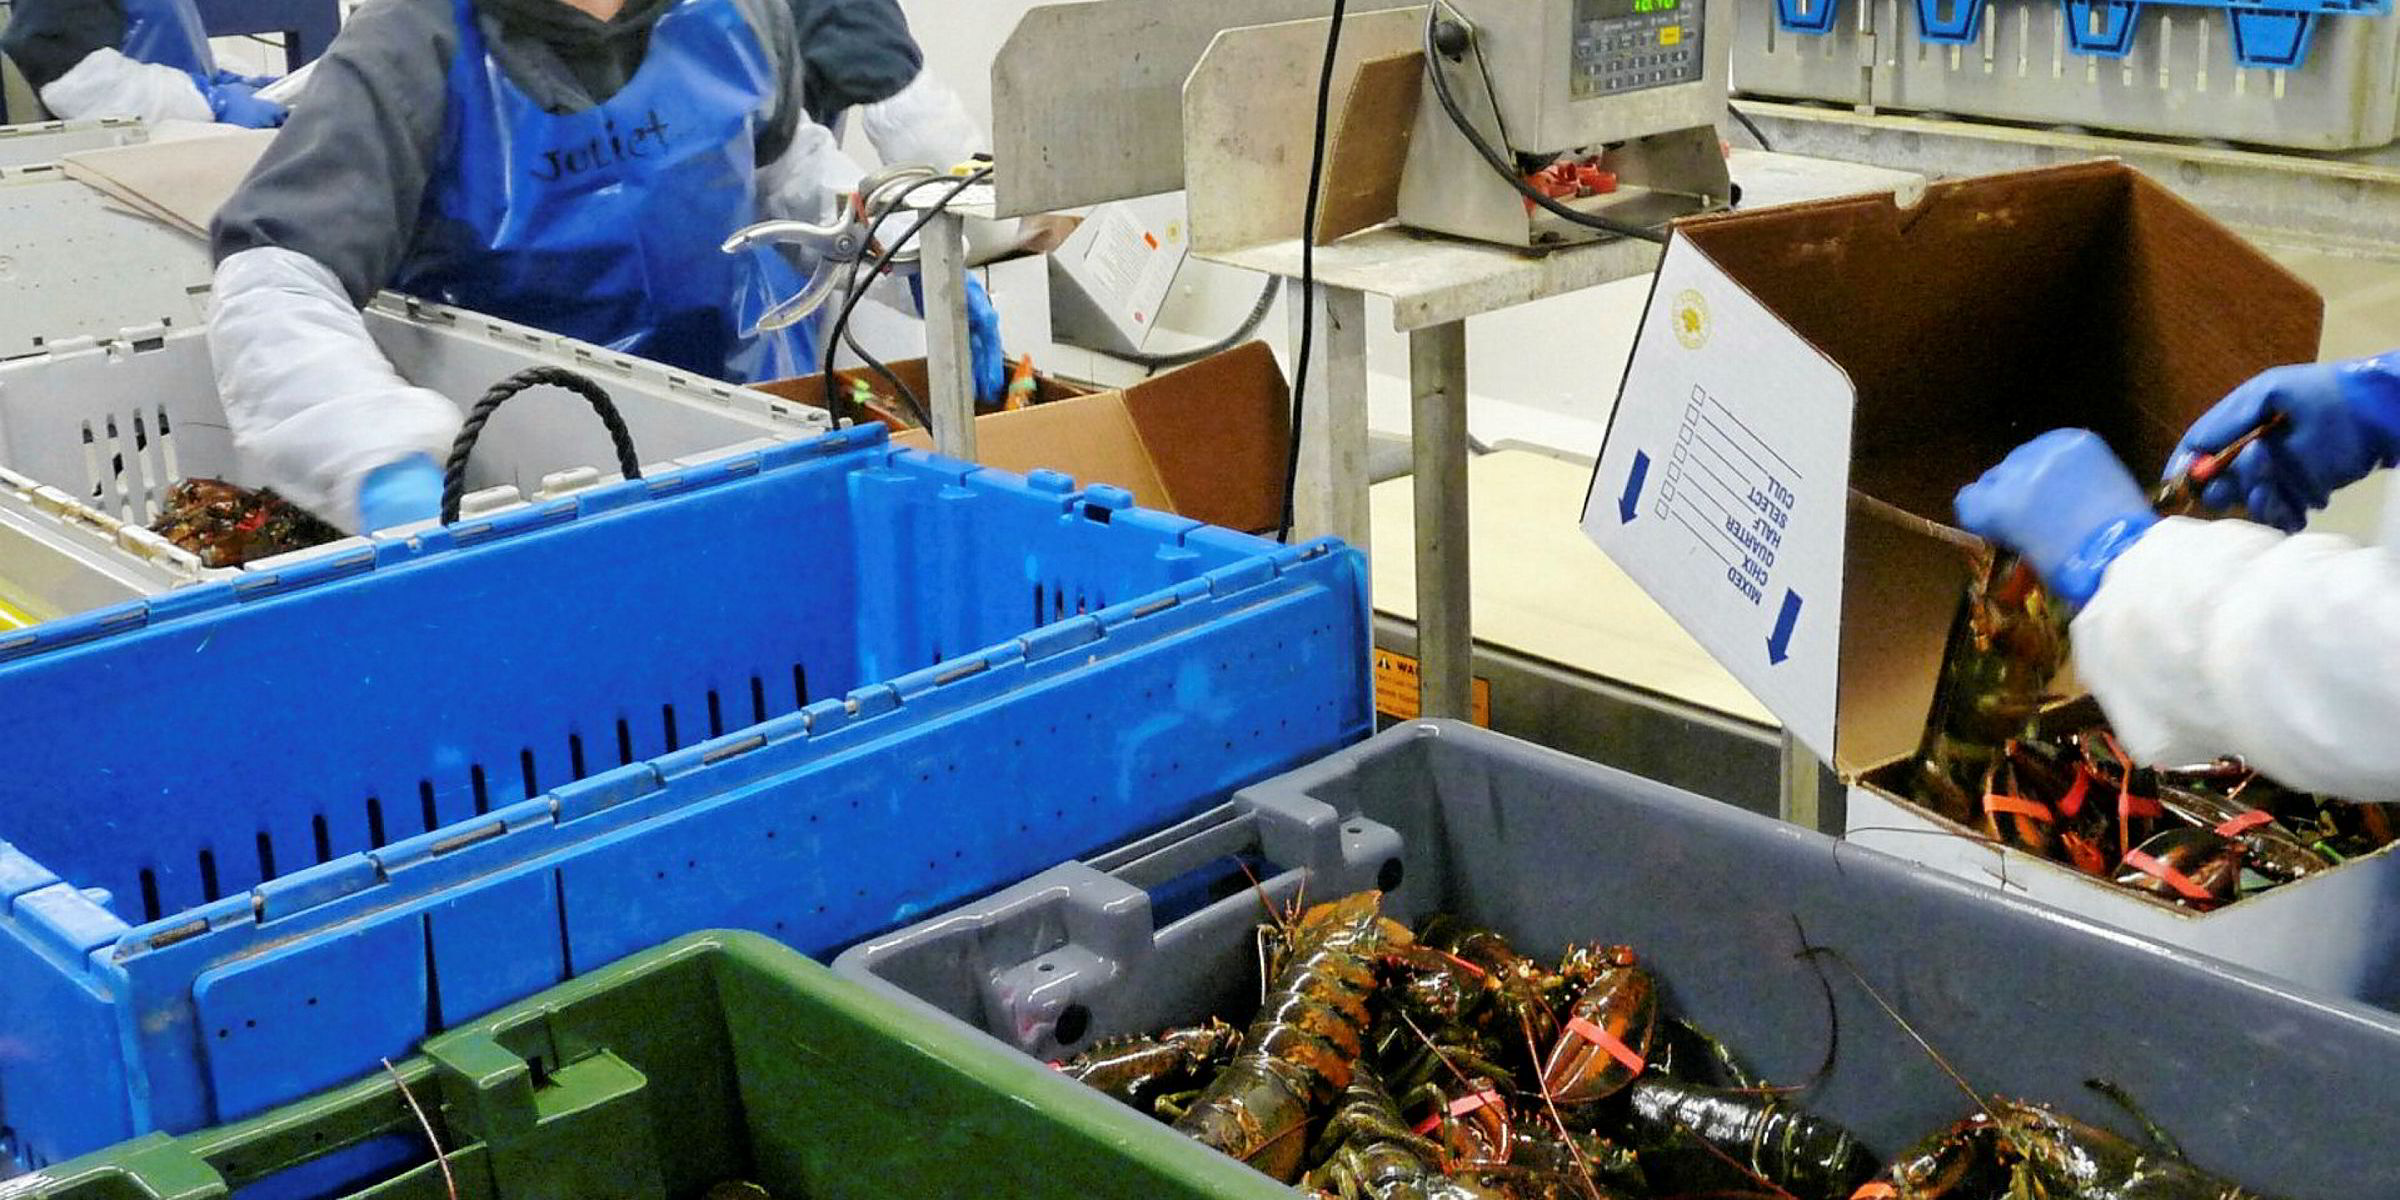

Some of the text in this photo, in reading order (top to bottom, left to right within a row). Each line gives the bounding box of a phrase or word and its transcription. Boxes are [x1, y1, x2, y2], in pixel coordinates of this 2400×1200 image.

[1747, 487, 1788, 529] SELECT
[1767, 475, 1795, 510] CULL
[1726, 515, 1775, 567] QUARTER
[1753, 518, 1782, 548] HALF
[1727, 568, 1762, 606] MIXED
[1742, 555, 1769, 587] CHIX
